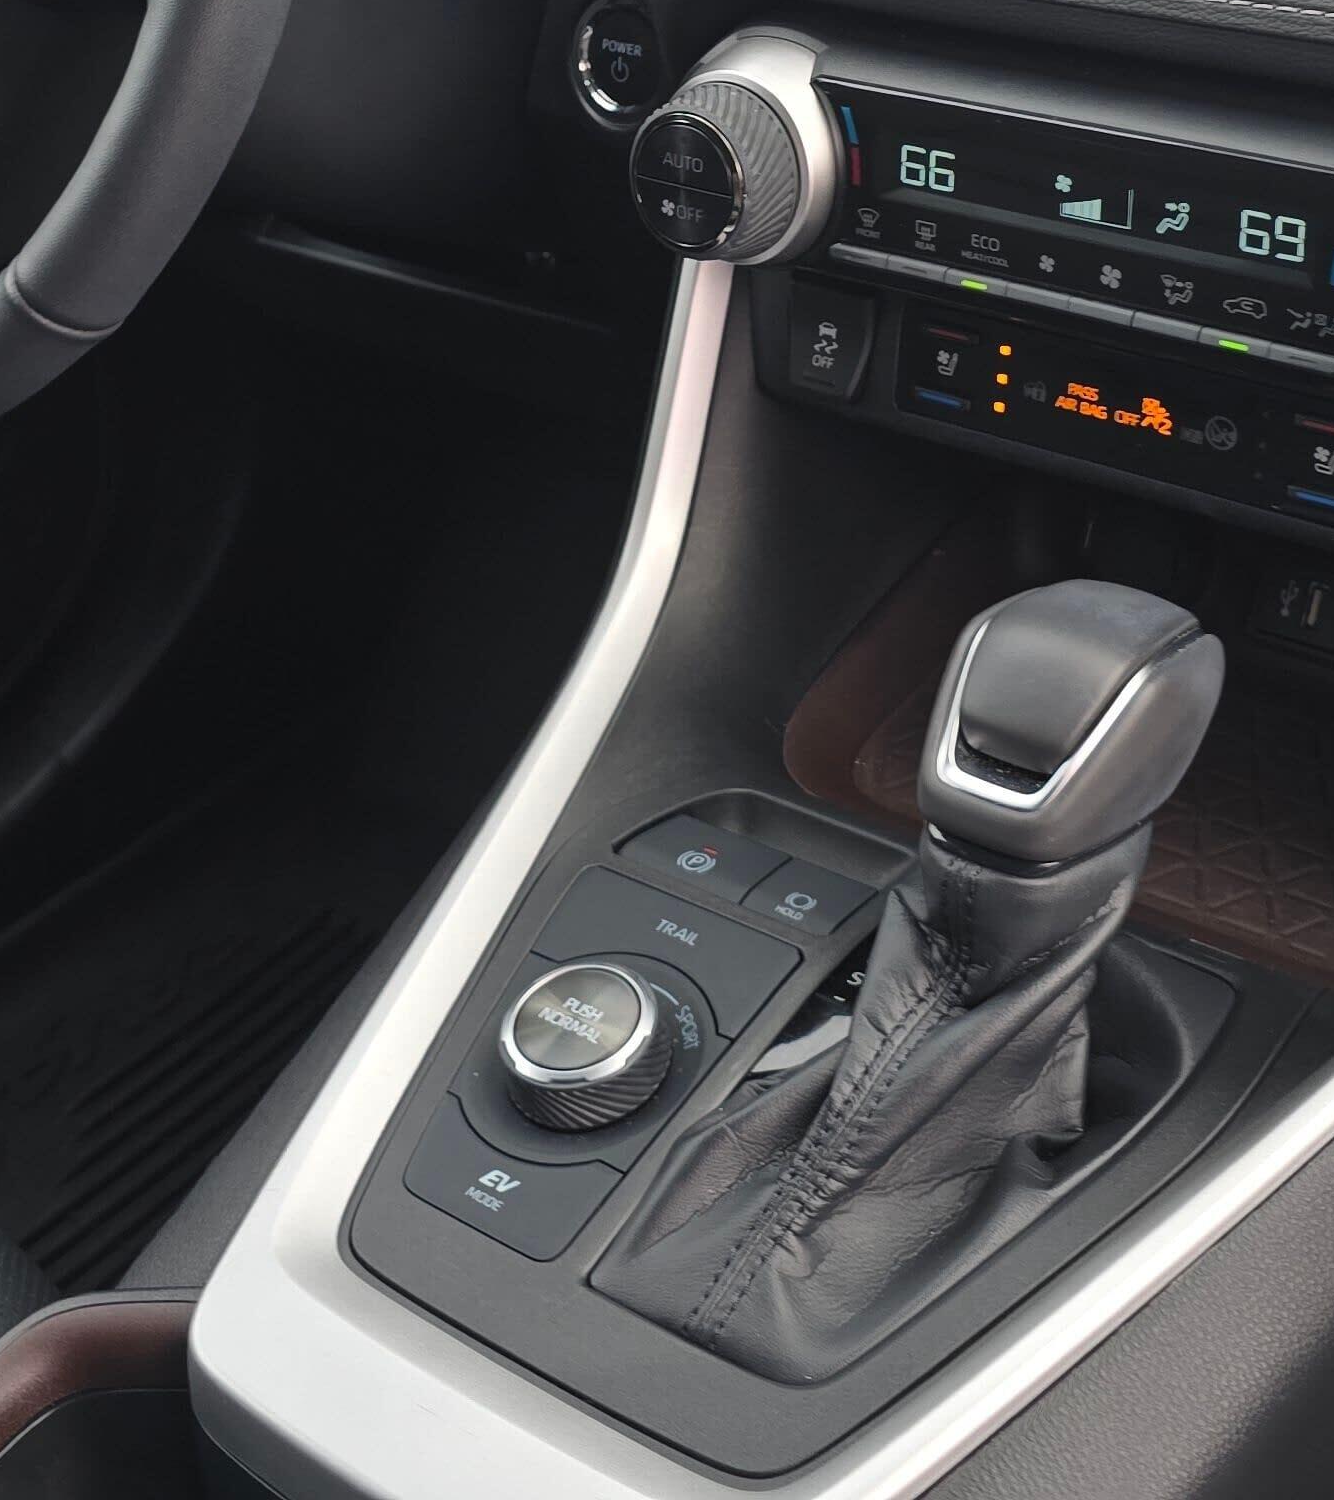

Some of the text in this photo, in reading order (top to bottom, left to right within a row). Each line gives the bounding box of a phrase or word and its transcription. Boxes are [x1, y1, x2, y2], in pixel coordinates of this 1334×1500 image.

[602, 38, 643, 57] POWER
[662, 151, 704, 173] AUTO
[900, 144, 956, 193] 66
[676, 204, 704, 223] OFF
[971, 233, 1001, 252] ECO
[1238, 209, 1306, 263] 69
[961, 250, 1010, 268] HEAT/COOL
[811, 354, 836, 369] OFF
[1068, 383, 1099, 401] PASS
[1079, 401, 1108, 420] BAG
[1113, 410, 1141, 427] OFF
[774, 904, 804, 921] HOLD
[655, 918, 700, 946] TRAIL
[562, 997, 604, 1021] PUSH
[538, 1007, 601, 1044] NORMAL
[675, 1004, 701, 1050] SPORT
[478, 1169, 522, 1193] EV
[464, 1186, 505, 1212] MODE
